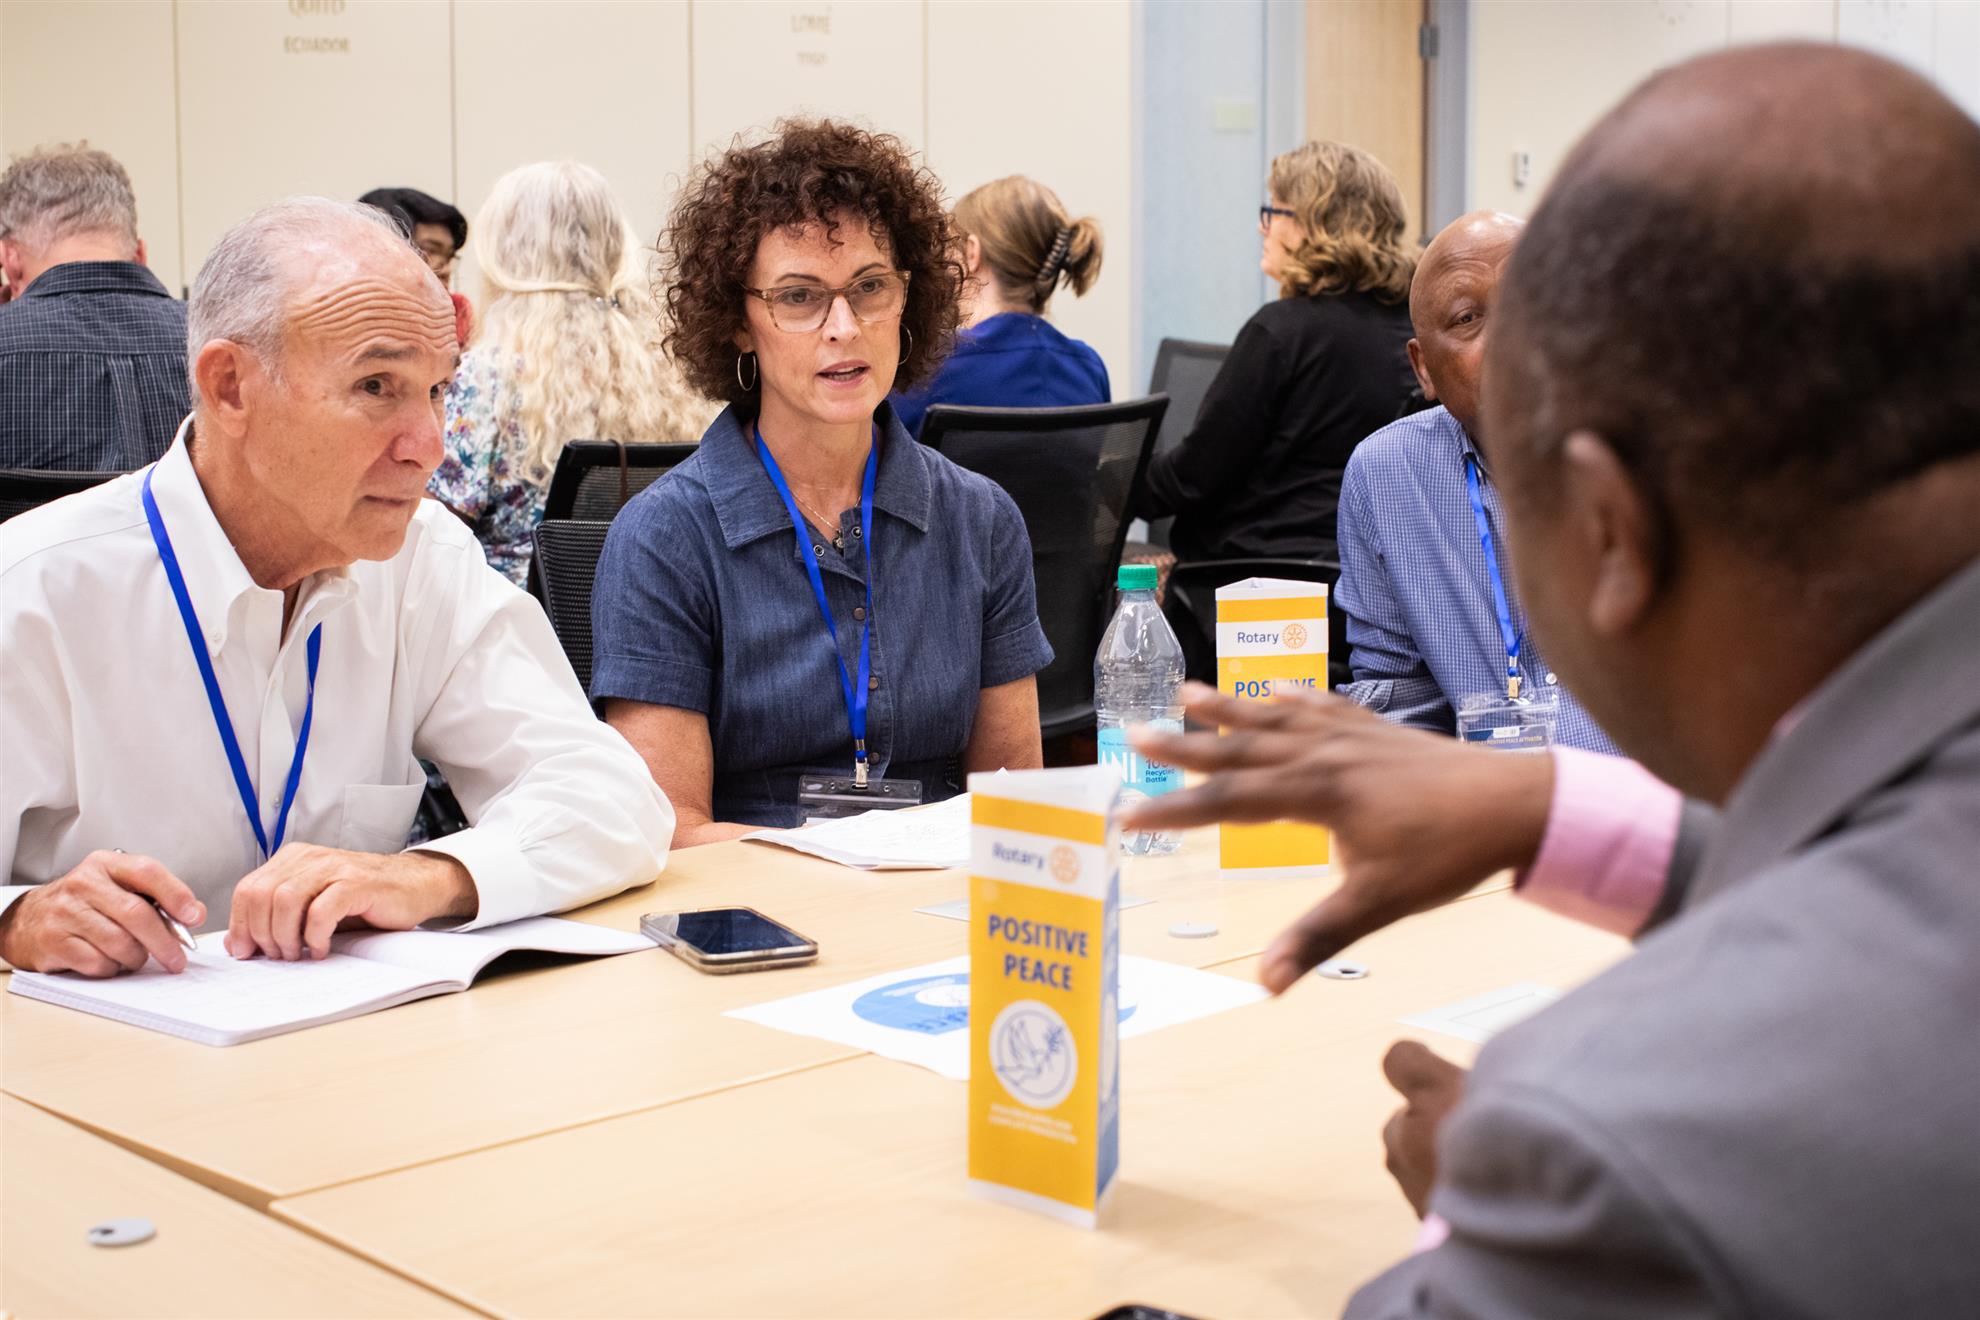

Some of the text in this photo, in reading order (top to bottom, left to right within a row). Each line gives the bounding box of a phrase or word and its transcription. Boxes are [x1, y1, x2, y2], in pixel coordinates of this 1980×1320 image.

[283, 35, 350, 54] ECUADOR
[1237, 631, 1279, 645] Rotary
[992, 841, 1044, 871] Rotary
[988, 913, 1088, 958] POSITIVE
[1004, 953, 1073, 991] PEACE
